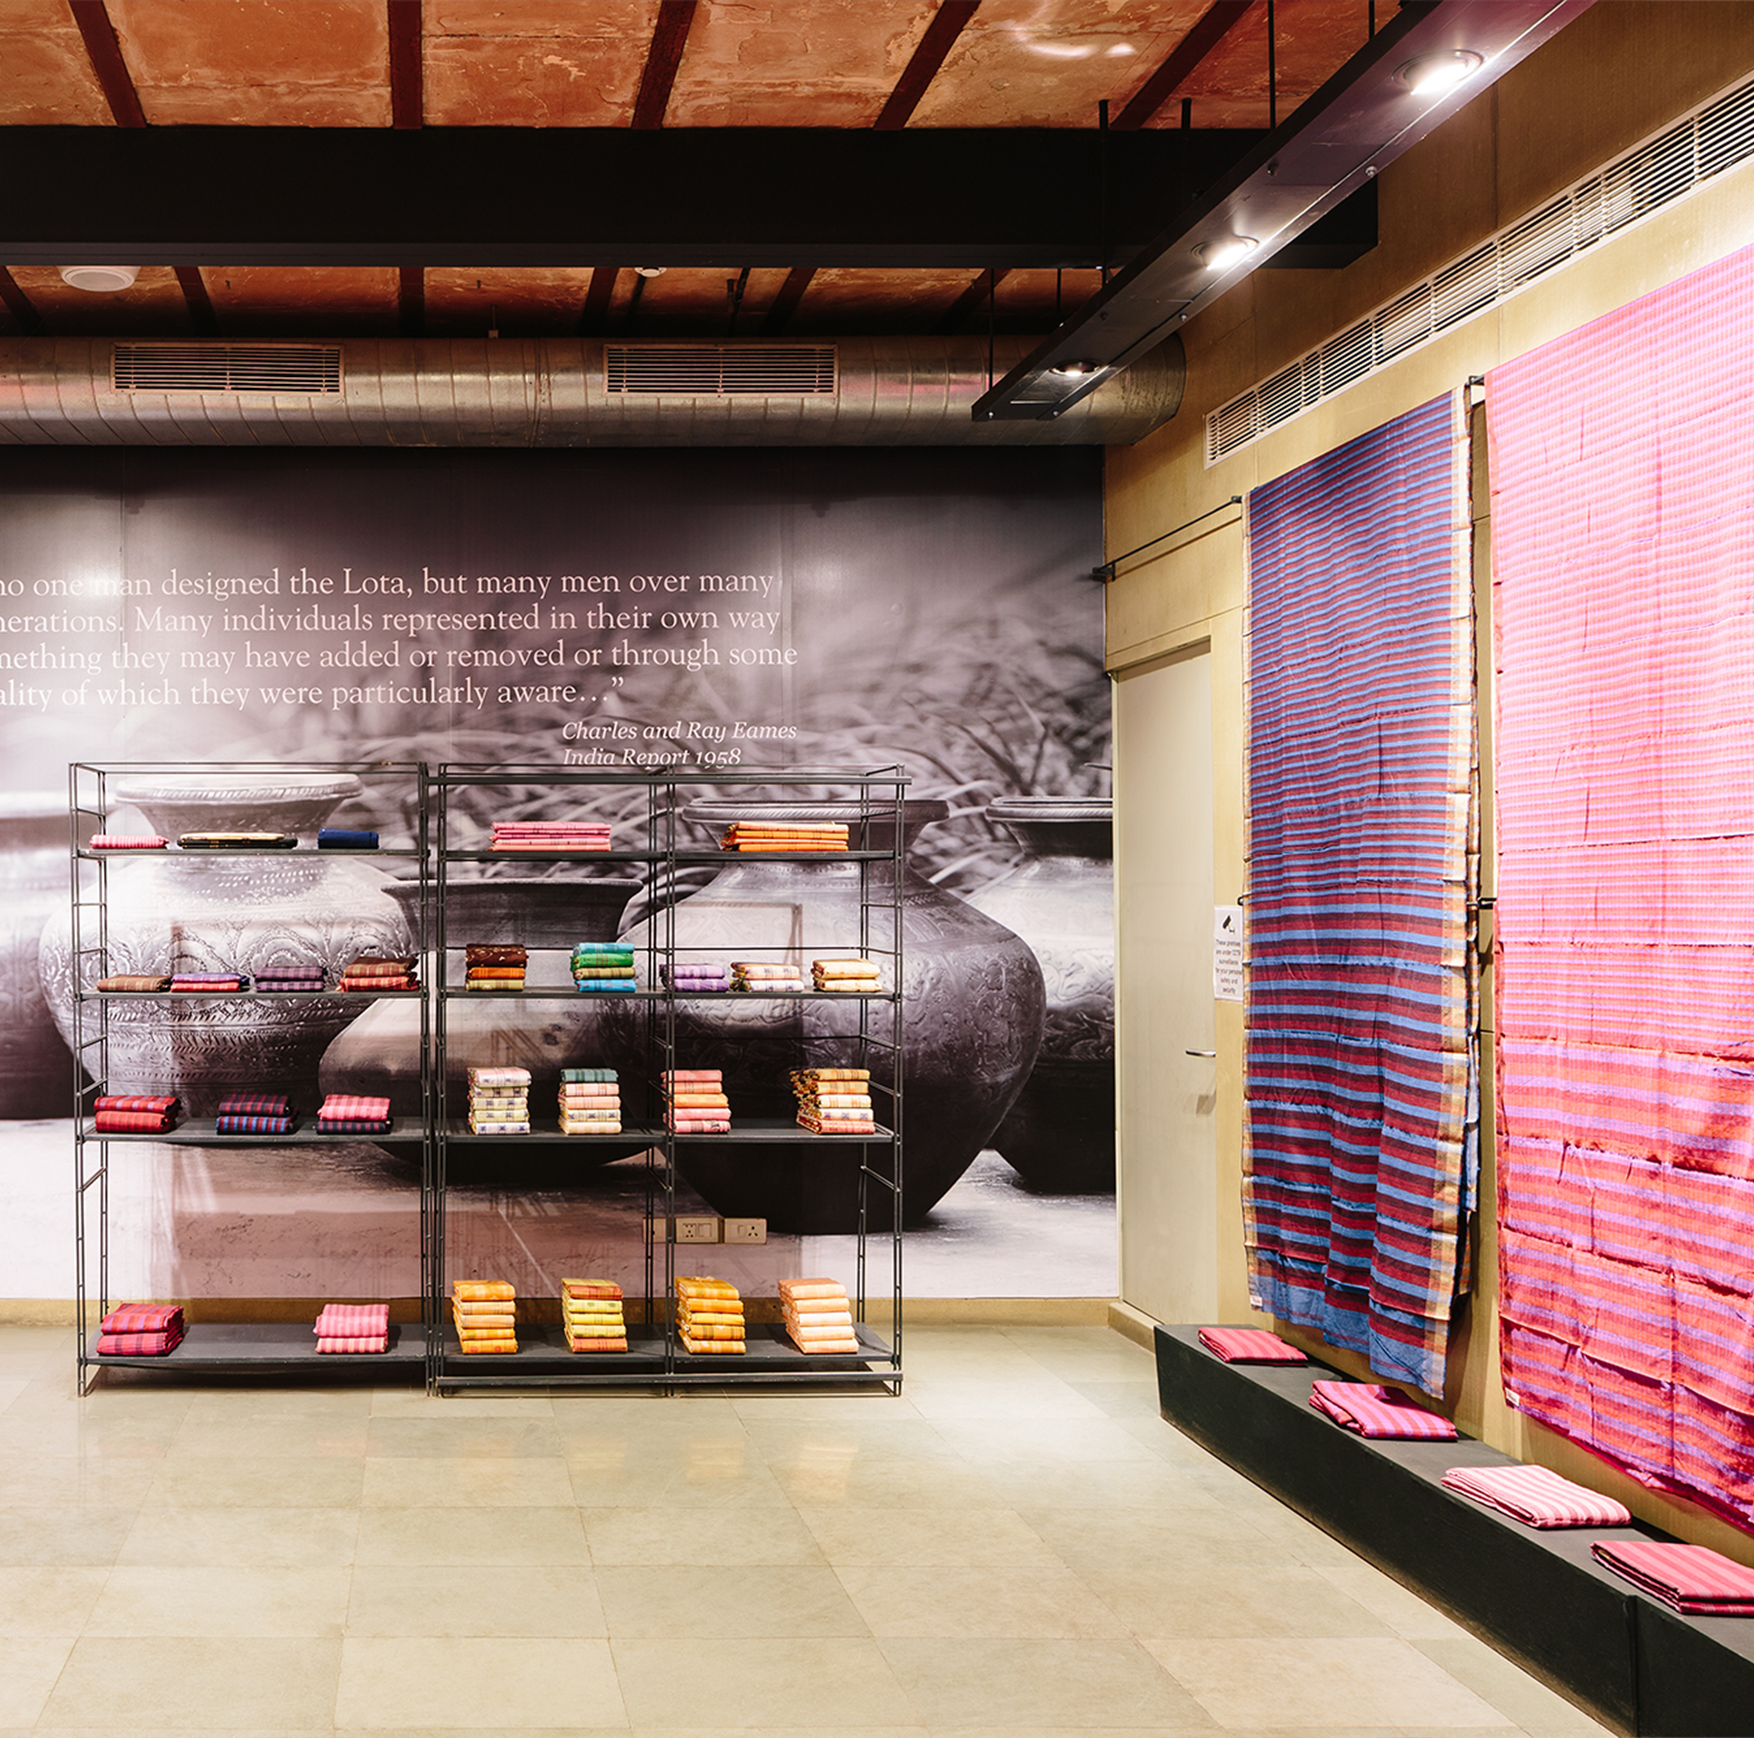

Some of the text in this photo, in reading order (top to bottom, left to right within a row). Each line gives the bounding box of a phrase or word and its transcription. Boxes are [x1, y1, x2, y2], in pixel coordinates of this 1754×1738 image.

[33, 578, 83, 596] one
[91, 577, 152, 596] man
[162, 569, 280, 601] designed
[290, 569, 334, 594] the
[344, 568, 413, 598] Lota,
[423, 567, 467, 594] but
[477, 574, 551, 599] many
[561, 574, 621, 593] men
[630, 574, 690, 593] over
[700, 573, 773, 597] many
[135, 606, 212, 637] Many
[223, 604, 373, 632] individuals
[383, 604, 539, 636] represented
[551, 606, 578, 630] in
[587, 604, 651, 630] their
[661, 610, 720, 629] own
[729, 610, 780, 635] way
[112, 642, 170, 674] they
[180, 648, 235, 673] may
[244, 642, 310, 668] have
[320, 640, 400, 667] added
[410, 648, 439, 667] or
[447, 640, 564, 667] removed
[574, 647, 602, 666] or
[612, 639, 720, 671] through
[729, 646, 798, 665] some
[62, 679, 90, 706] of
[97, 679, 180, 706] which
[191, 678, 250, 710] they
[259, 685, 323, 704] were
[332, 676, 488, 710] particularly
[562, 721, 797, 743] Charles and Ray Eames
[563, 748, 741, 770] India Report 1958
